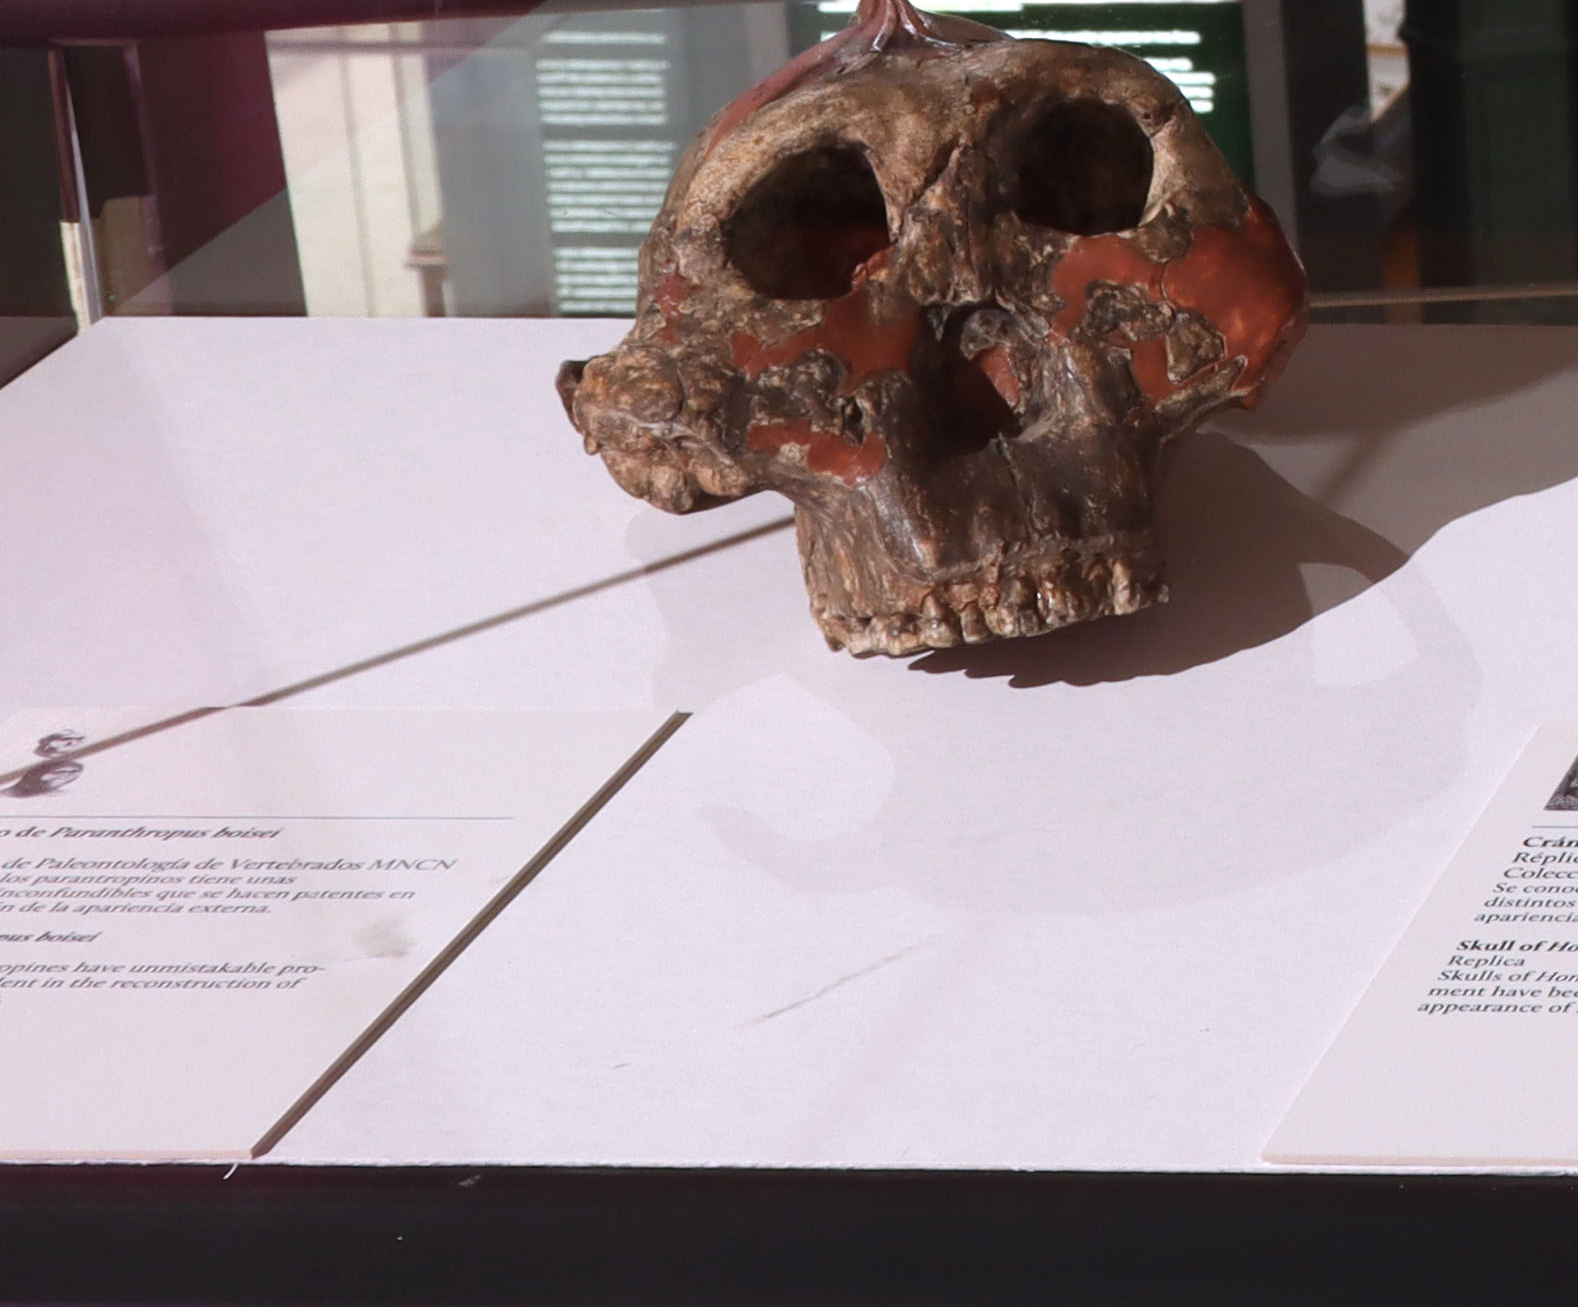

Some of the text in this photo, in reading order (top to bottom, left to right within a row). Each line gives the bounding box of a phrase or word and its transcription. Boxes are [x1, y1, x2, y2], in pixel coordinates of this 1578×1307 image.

[14, 826, 46, 838] de
[49, 826, 206, 841] Paranthropus
[212, 827, 283, 838] boisei
[1, 858, 454, 872] de Paleontología de Vertebrados MNCN
[31, 873, 296, 887] parantropinos tiene unas
[155, 888, 415, 902] que se hacen patentes en
[18, 901, 270, 915] de la apariencia externa.
[1484, 896, 1574, 909] distintos
[34, 931, 101, 942] boisei
[1456, 939, 1515, 952] Skull
[1518, 940, 1546, 952] of
[72, 962, 325, 977] have unmistakable pro-
[1447, 955, 1525, 970] Replica
[40, 977, 305, 989] in the reconstruction of
[1437, 970, 1500, 982] Skulls
[1507, 970, 1531, 983] of
